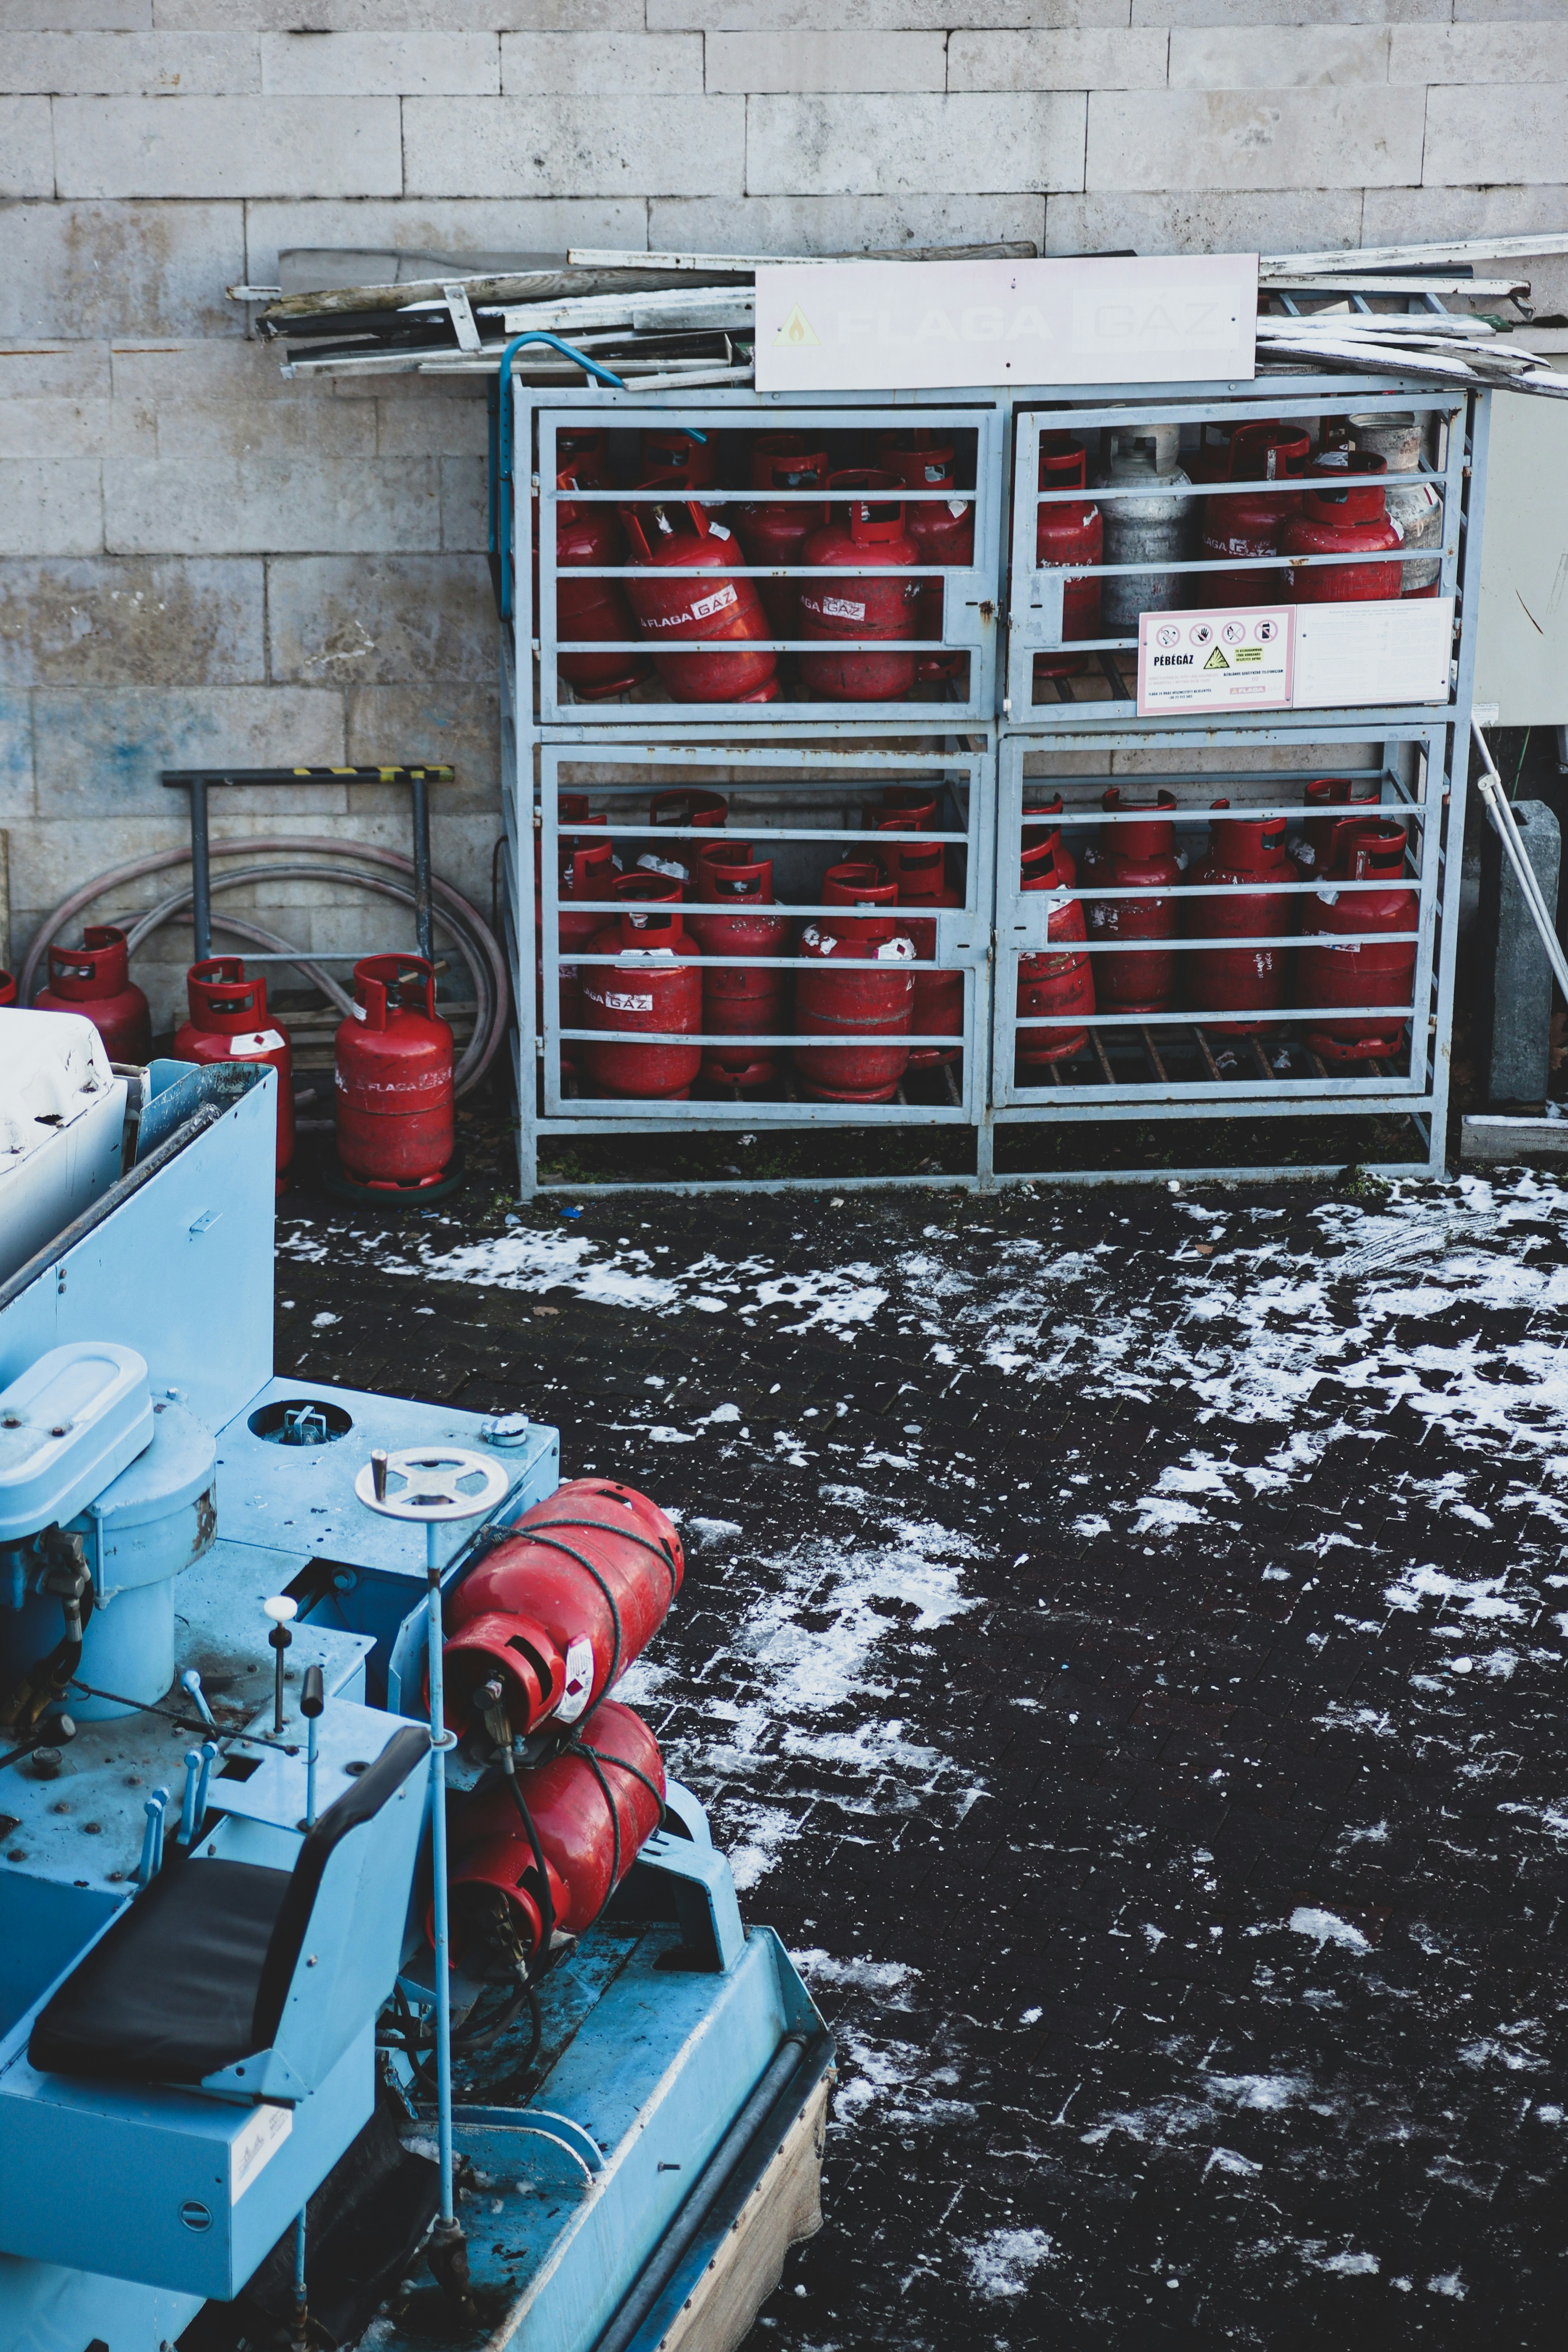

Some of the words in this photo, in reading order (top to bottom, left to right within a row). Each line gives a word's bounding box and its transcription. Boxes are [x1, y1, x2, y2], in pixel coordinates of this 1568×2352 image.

[837, 304, 1054, 345] FLAGA
[1093, 292, 1220, 339] GÁZ
[647, 613, 693, 628] FLAGA
[698, 591, 733, 616] GÁZ
[800, 594, 821, 613] AGA
[1154, 653, 1194, 666] PÉBÉGÁZ
[584, 988, 604, 1004] AGA
